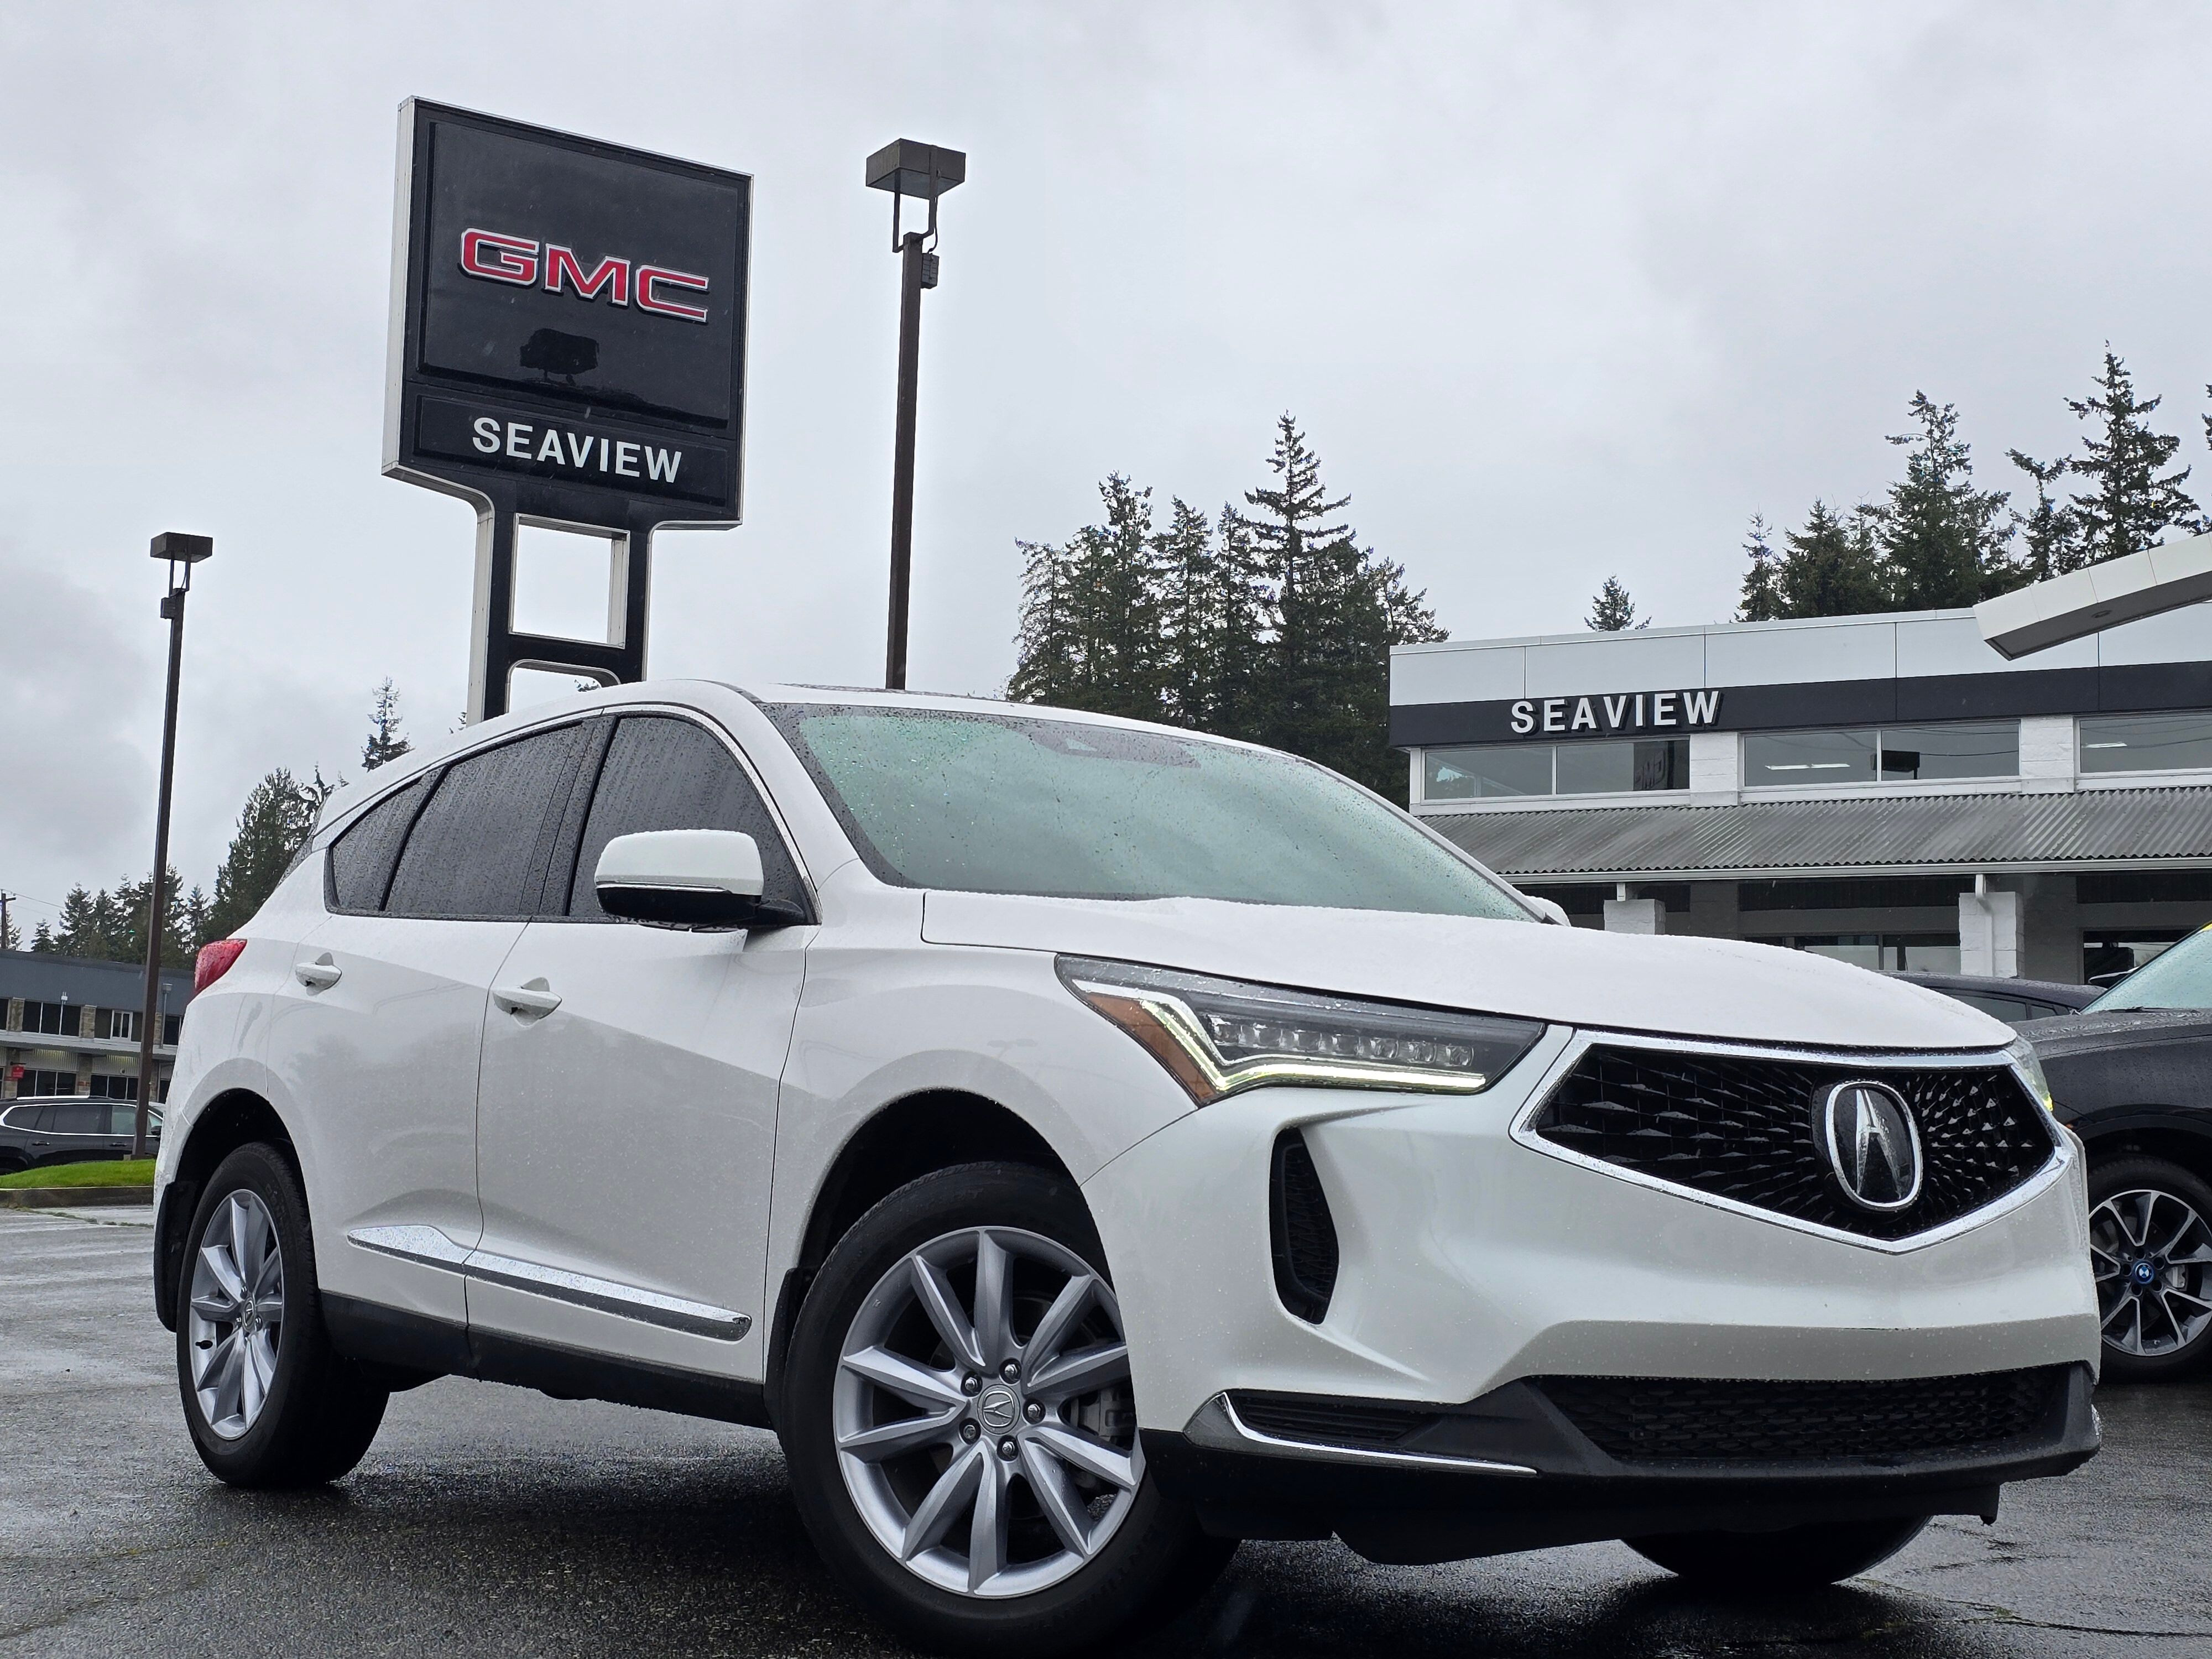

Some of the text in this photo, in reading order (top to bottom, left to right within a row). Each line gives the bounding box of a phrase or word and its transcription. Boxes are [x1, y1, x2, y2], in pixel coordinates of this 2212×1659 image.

[461, 228, 709, 322] GMC
[472, 417, 682, 484] SEAVIEW
[1510, 690, 1720, 734] SEAVIEW
